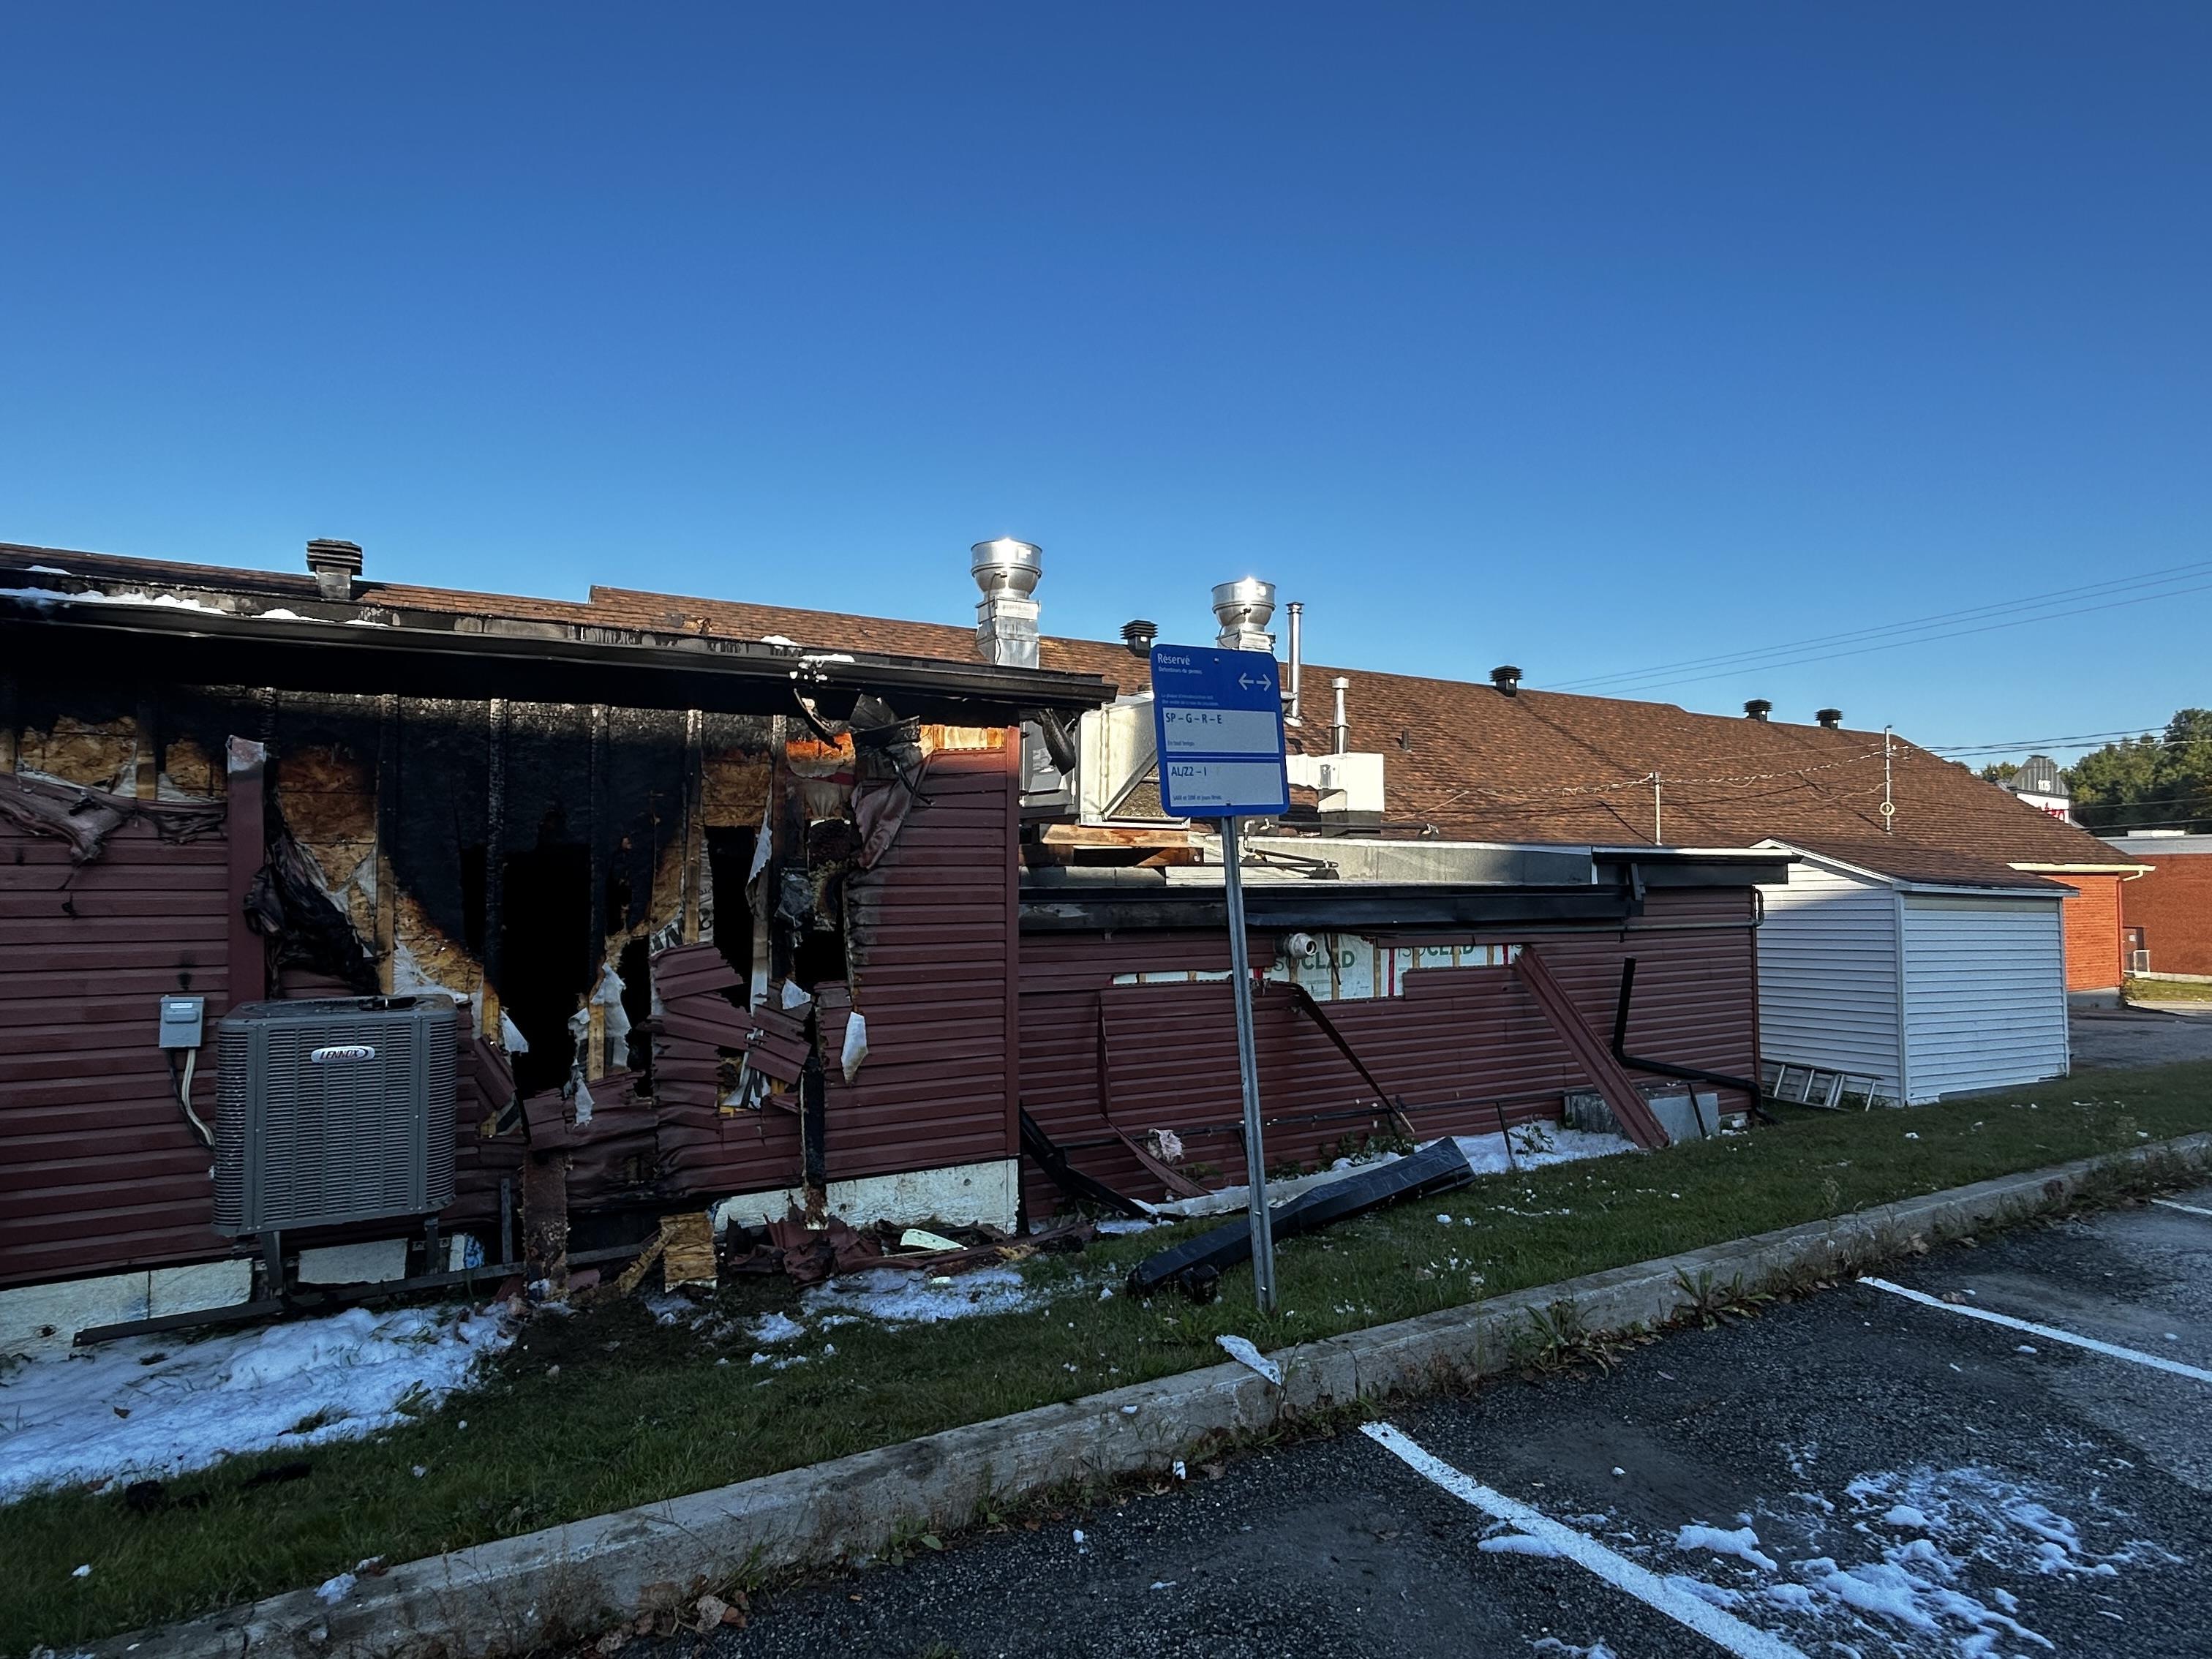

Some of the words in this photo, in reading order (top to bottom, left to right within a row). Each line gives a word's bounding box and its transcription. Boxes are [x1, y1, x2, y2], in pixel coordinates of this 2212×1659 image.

[1157, 653, 1190, 665] Réservé
[1165, 712, 1176, 723] SP
[1186, 713, 1192, 723] G
[1202, 714, 1208, 723] R
[1216, 714, 1222, 724] E
[319, 1049, 360, 1060] LENNOX
